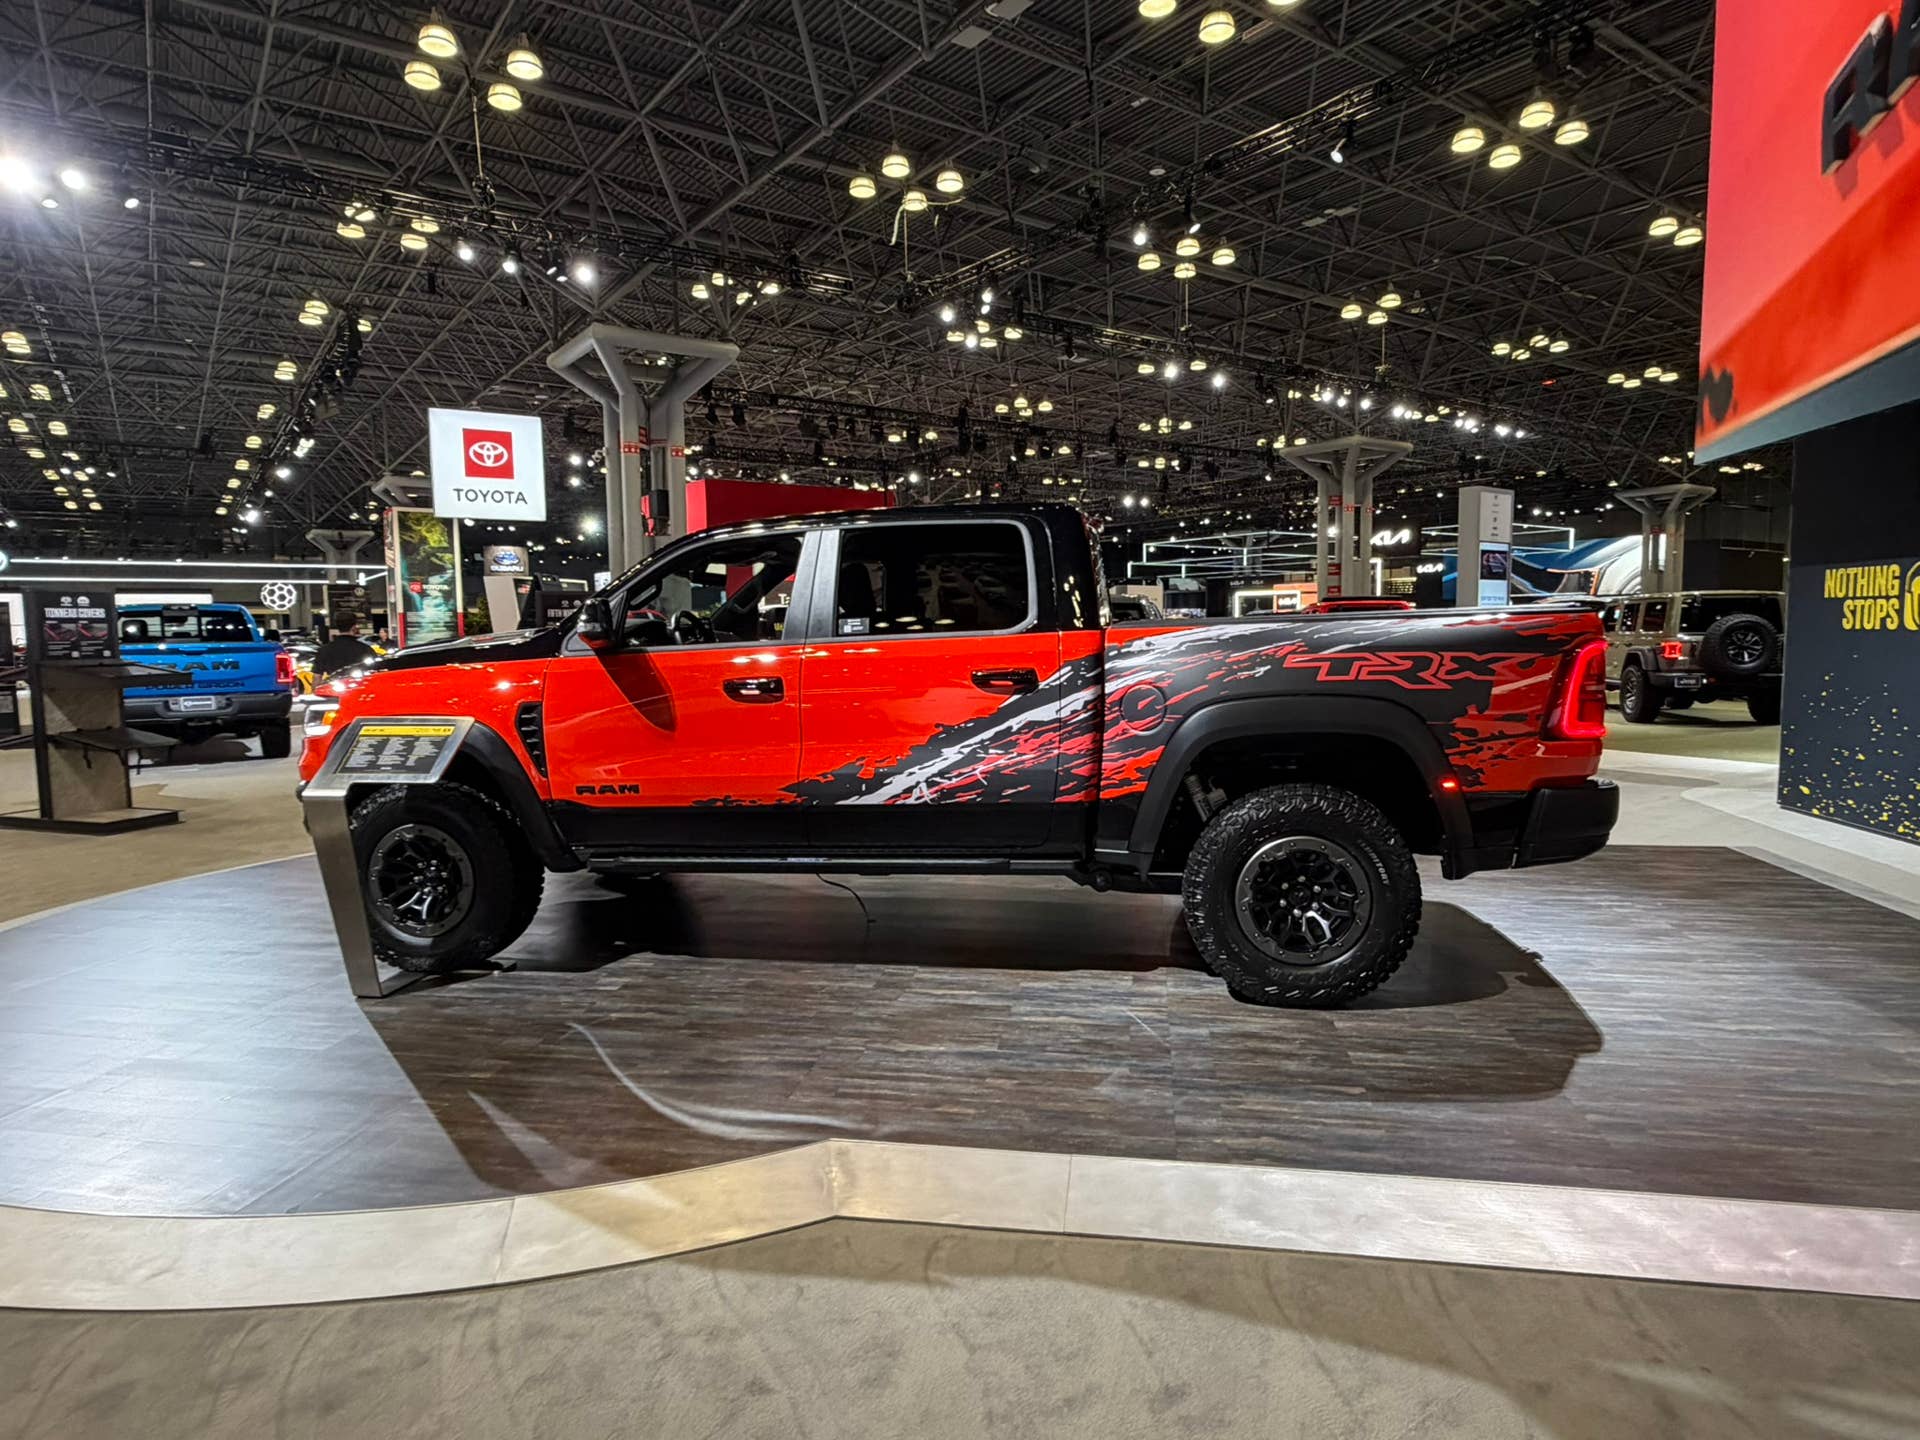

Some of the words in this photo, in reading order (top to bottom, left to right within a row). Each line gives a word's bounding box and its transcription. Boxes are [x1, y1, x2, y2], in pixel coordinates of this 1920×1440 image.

[1821, 0, 1920, 175] R
[452, 488, 528, 505] TOYOTA
[1369, 528, 1411, 546] KIA
[1823, 563, 1901, 598] NOTHING
[1841, 598, 1900, 631] STOPS
[1283, 651, 1546, 690] TRX
[575, 783, 641, 796] RAM
